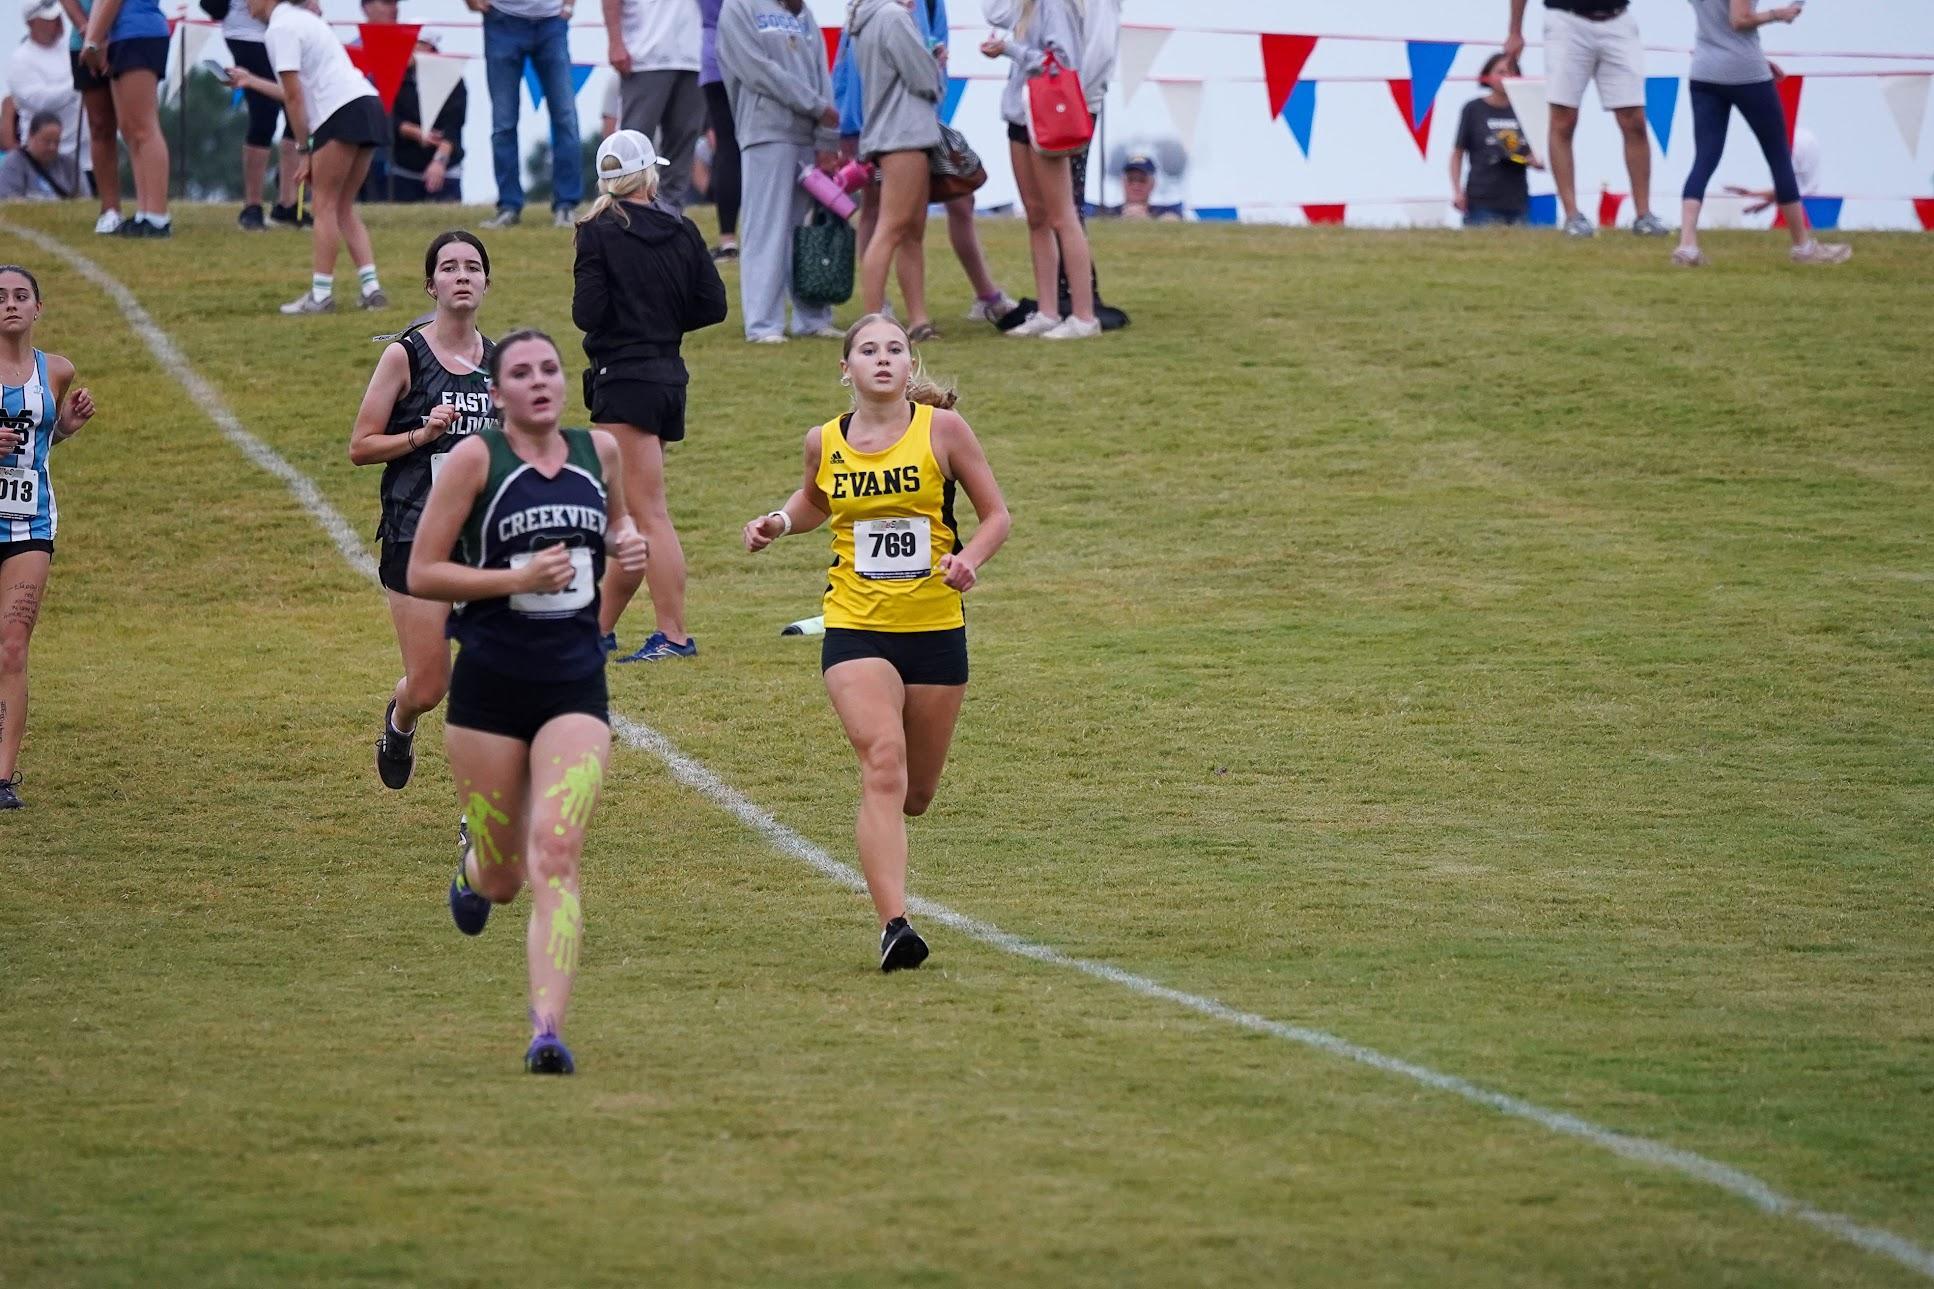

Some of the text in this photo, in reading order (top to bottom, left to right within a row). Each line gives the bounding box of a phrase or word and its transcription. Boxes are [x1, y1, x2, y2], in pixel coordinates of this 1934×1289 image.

[442, 391, 489, 413] EAST
[0, 478, 33, 503] 013
[832, 465, 920, 498] EVANS
[868, 532, 916, 558] 769
